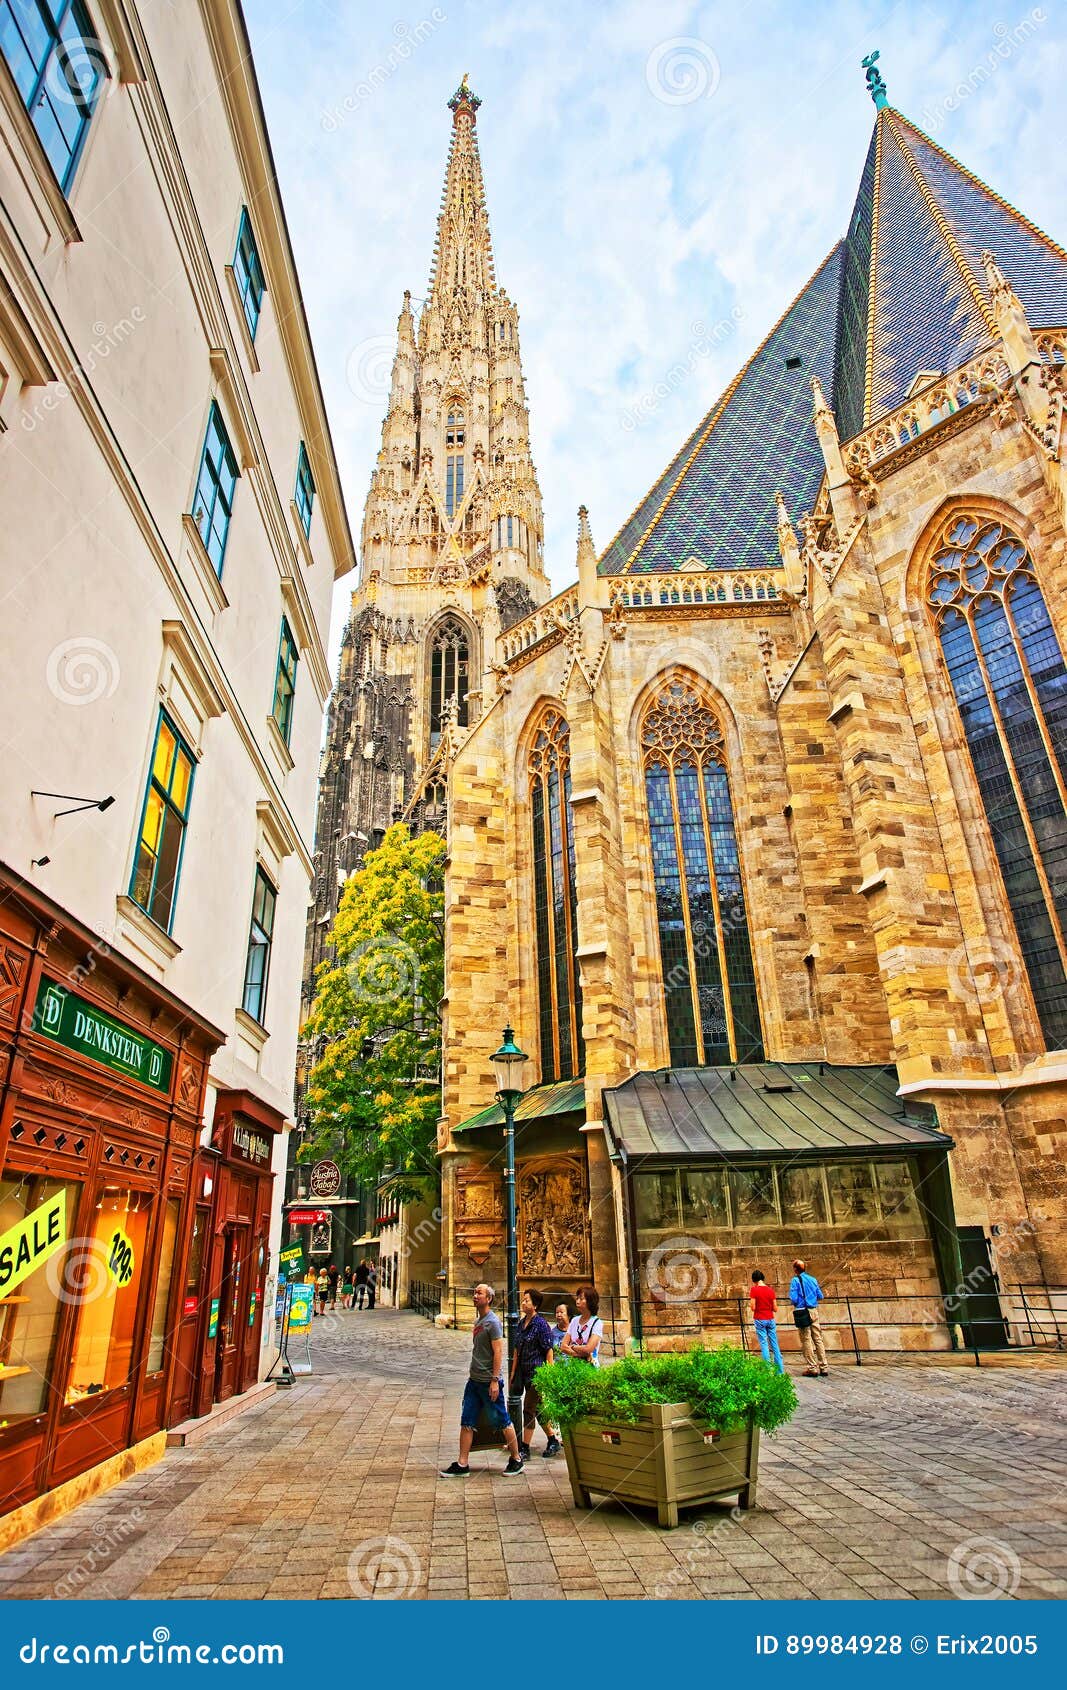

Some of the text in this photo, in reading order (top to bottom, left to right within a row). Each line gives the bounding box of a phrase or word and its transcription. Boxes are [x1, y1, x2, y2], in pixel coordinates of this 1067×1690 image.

[46, 996, 160, 1077] D DENKSTEIN D
[312, 1165, 338, 1180] Austria
[313, 1179, 338, 1191] Tabak
[0, 1206, 60, 1287] SALE
